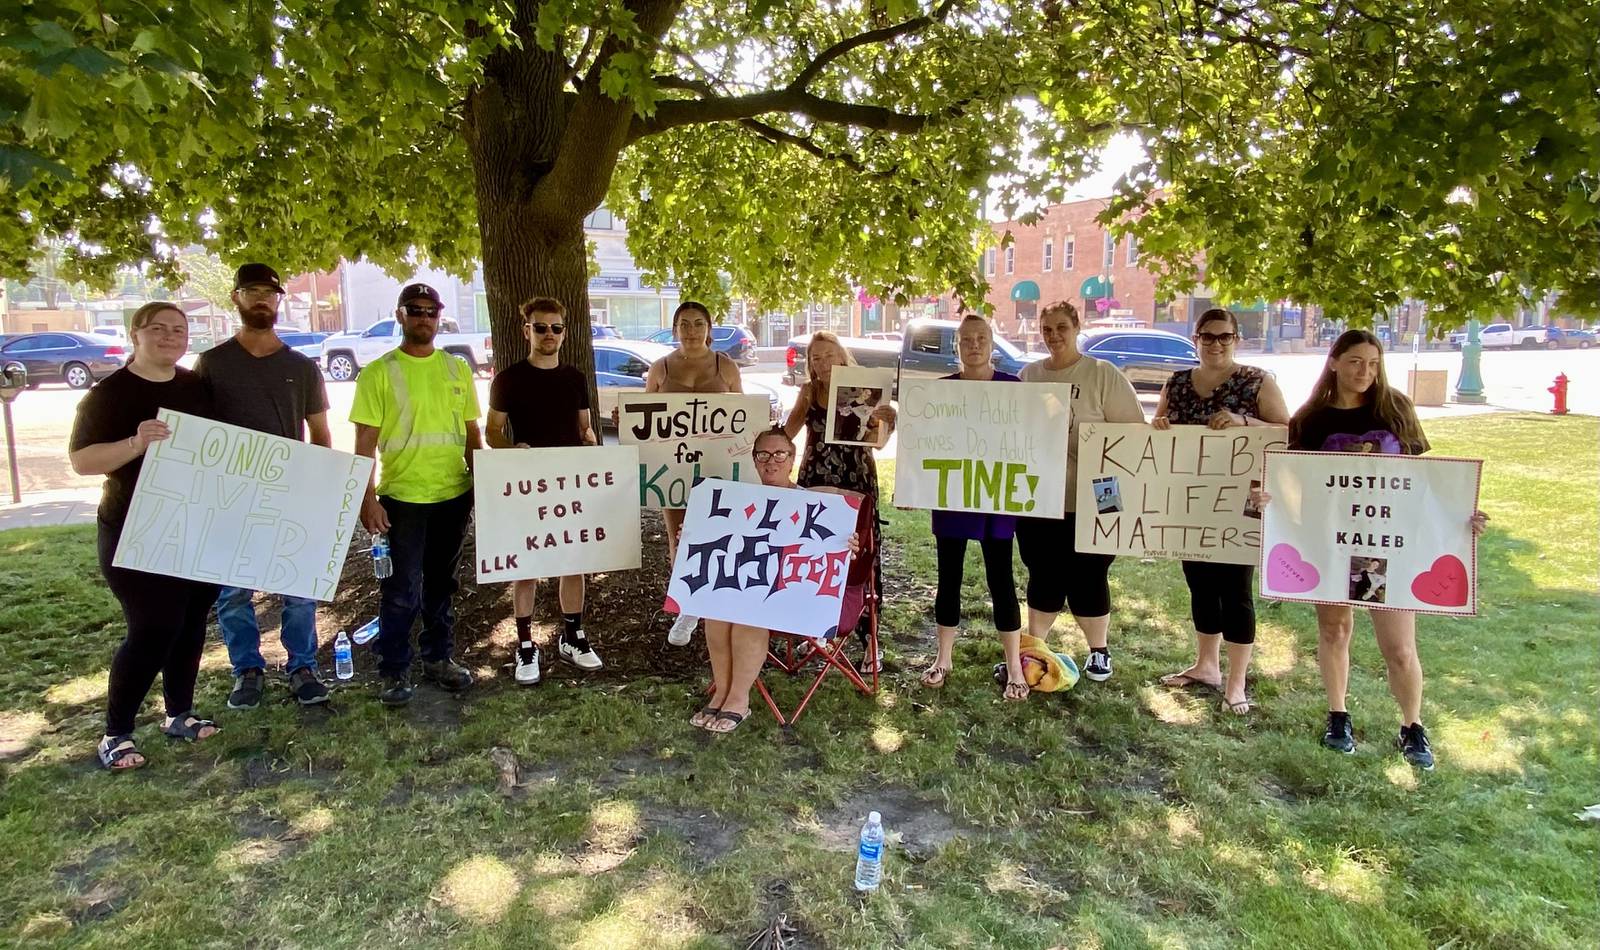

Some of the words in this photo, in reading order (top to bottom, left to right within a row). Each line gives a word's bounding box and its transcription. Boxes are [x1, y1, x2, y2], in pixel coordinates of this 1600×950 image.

[625, 398, 747, 441] Justice
[905, 385, 968, 420] Commit
[979, 390, 1022, 425] Adult
[155, 413, 290, 483] LONG
[674, 442, 703, 464] for
[966, 427, 988, 458] Do
[1000, 431, 1037, 464] Adult
[140, 460, 289, 518] LIVE
[502, 471, 614, 497] JUSTICE
[922, 459, 1040, 513] TIME!
[1141, 482, 1238, 515] LIFE
[1326, 475, 1412, 491] JUSTICE
[538, 500, 583, 521] FOR
[1352, 504, 1391, 519] FOR
[116, 495, 308, 591] KALEB
[526, 526, 607, 551] KALEB
[1092, 516, 1261, 550] MATTERS
[1336, 532, 1404, 548] KALEB
[480, 554, 519, 574] LLK
[680, 533, 850, 602] JUSTICE
